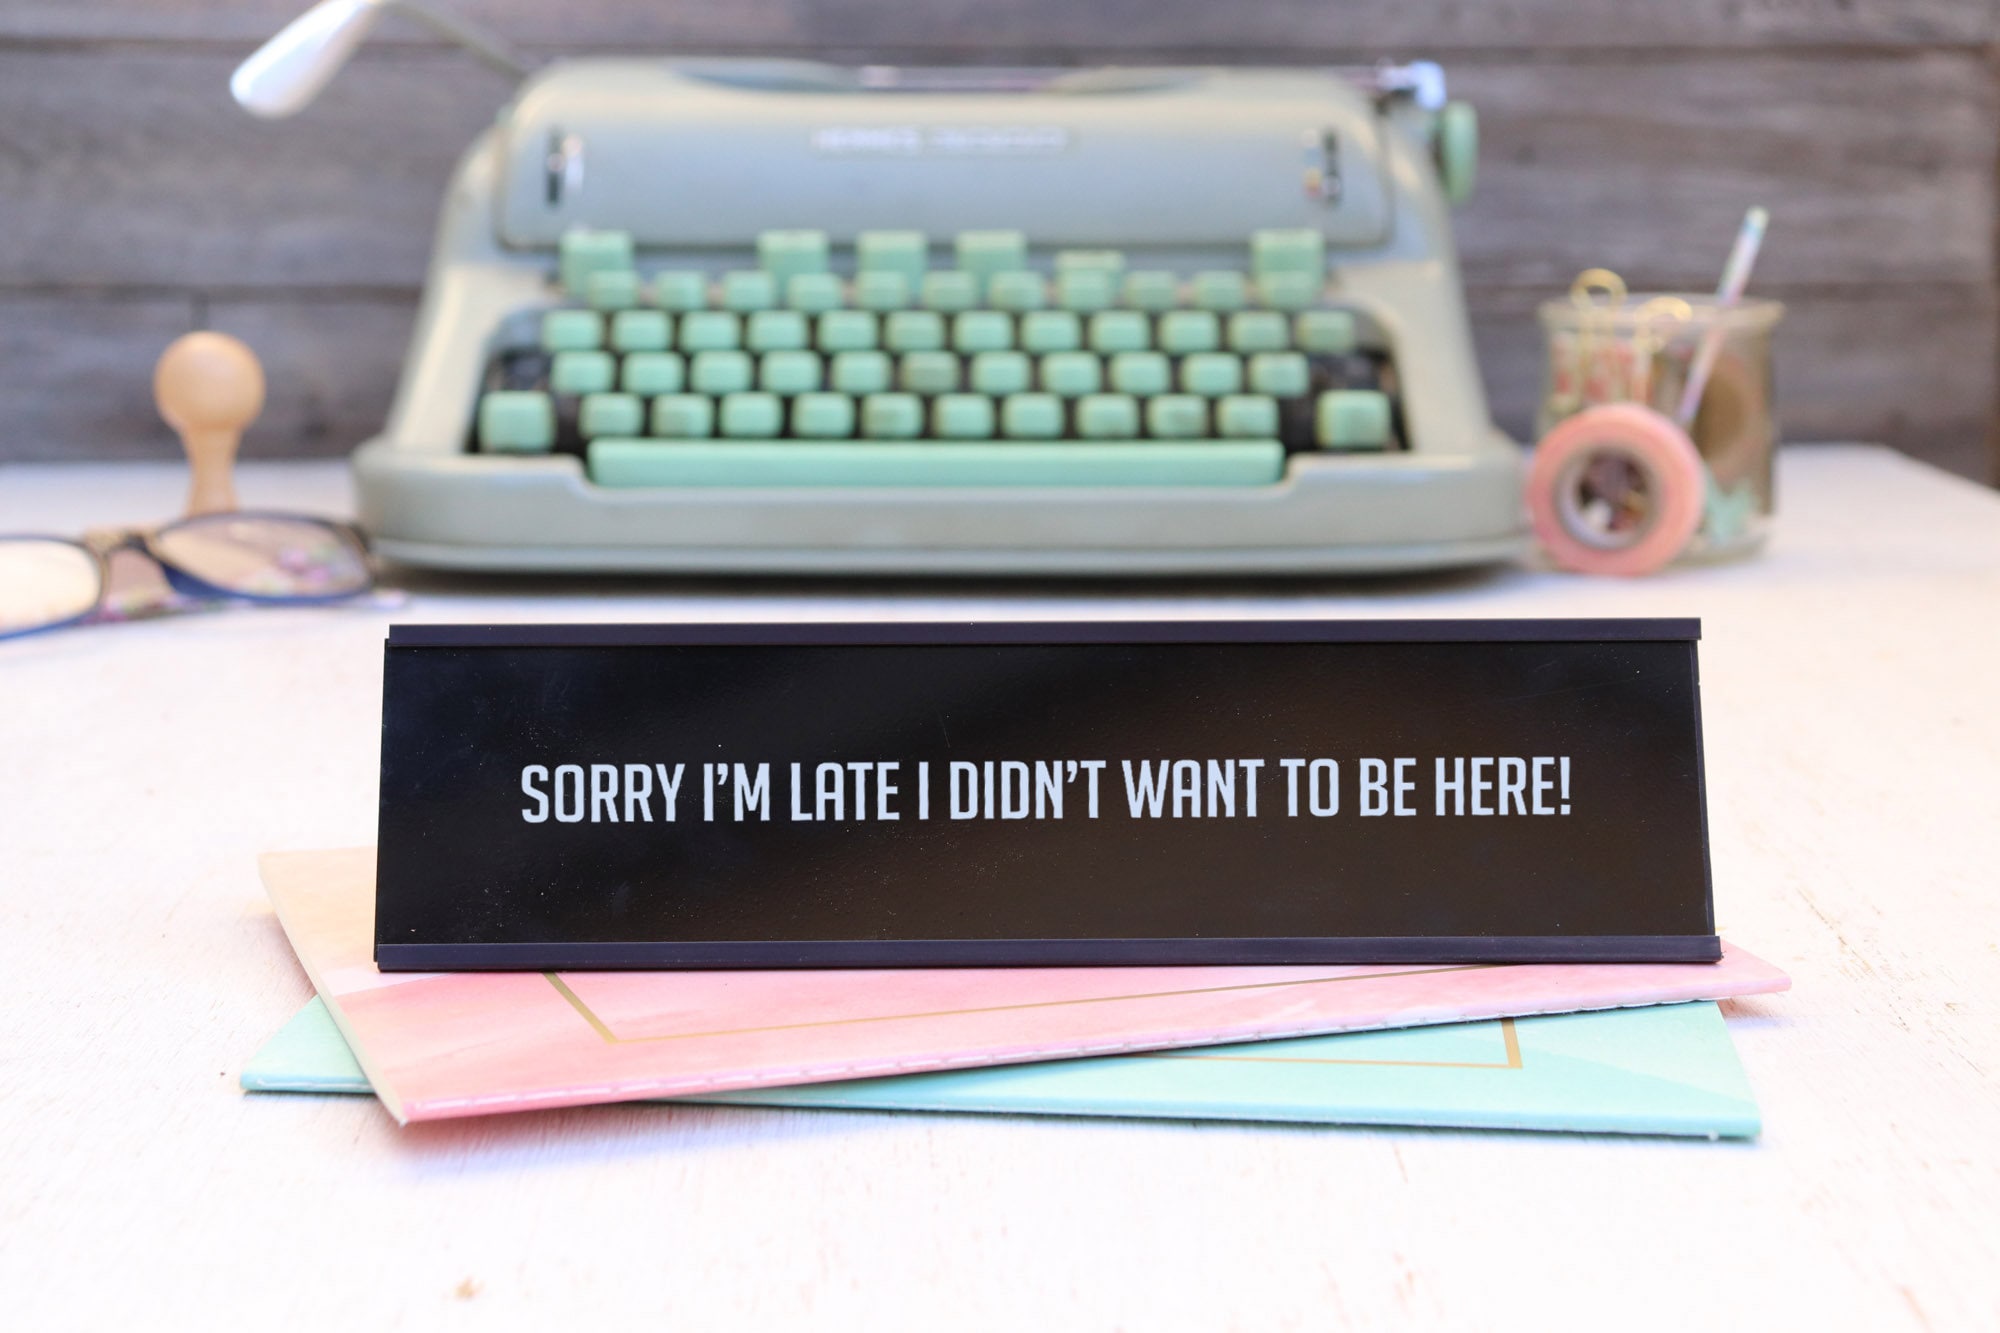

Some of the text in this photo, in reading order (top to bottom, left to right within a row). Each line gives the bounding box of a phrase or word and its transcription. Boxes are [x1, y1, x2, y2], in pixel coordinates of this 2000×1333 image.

[522, 756, 1572, 824] SORRY I'M LATE I DIDN'T WANT TO BE HERE!
